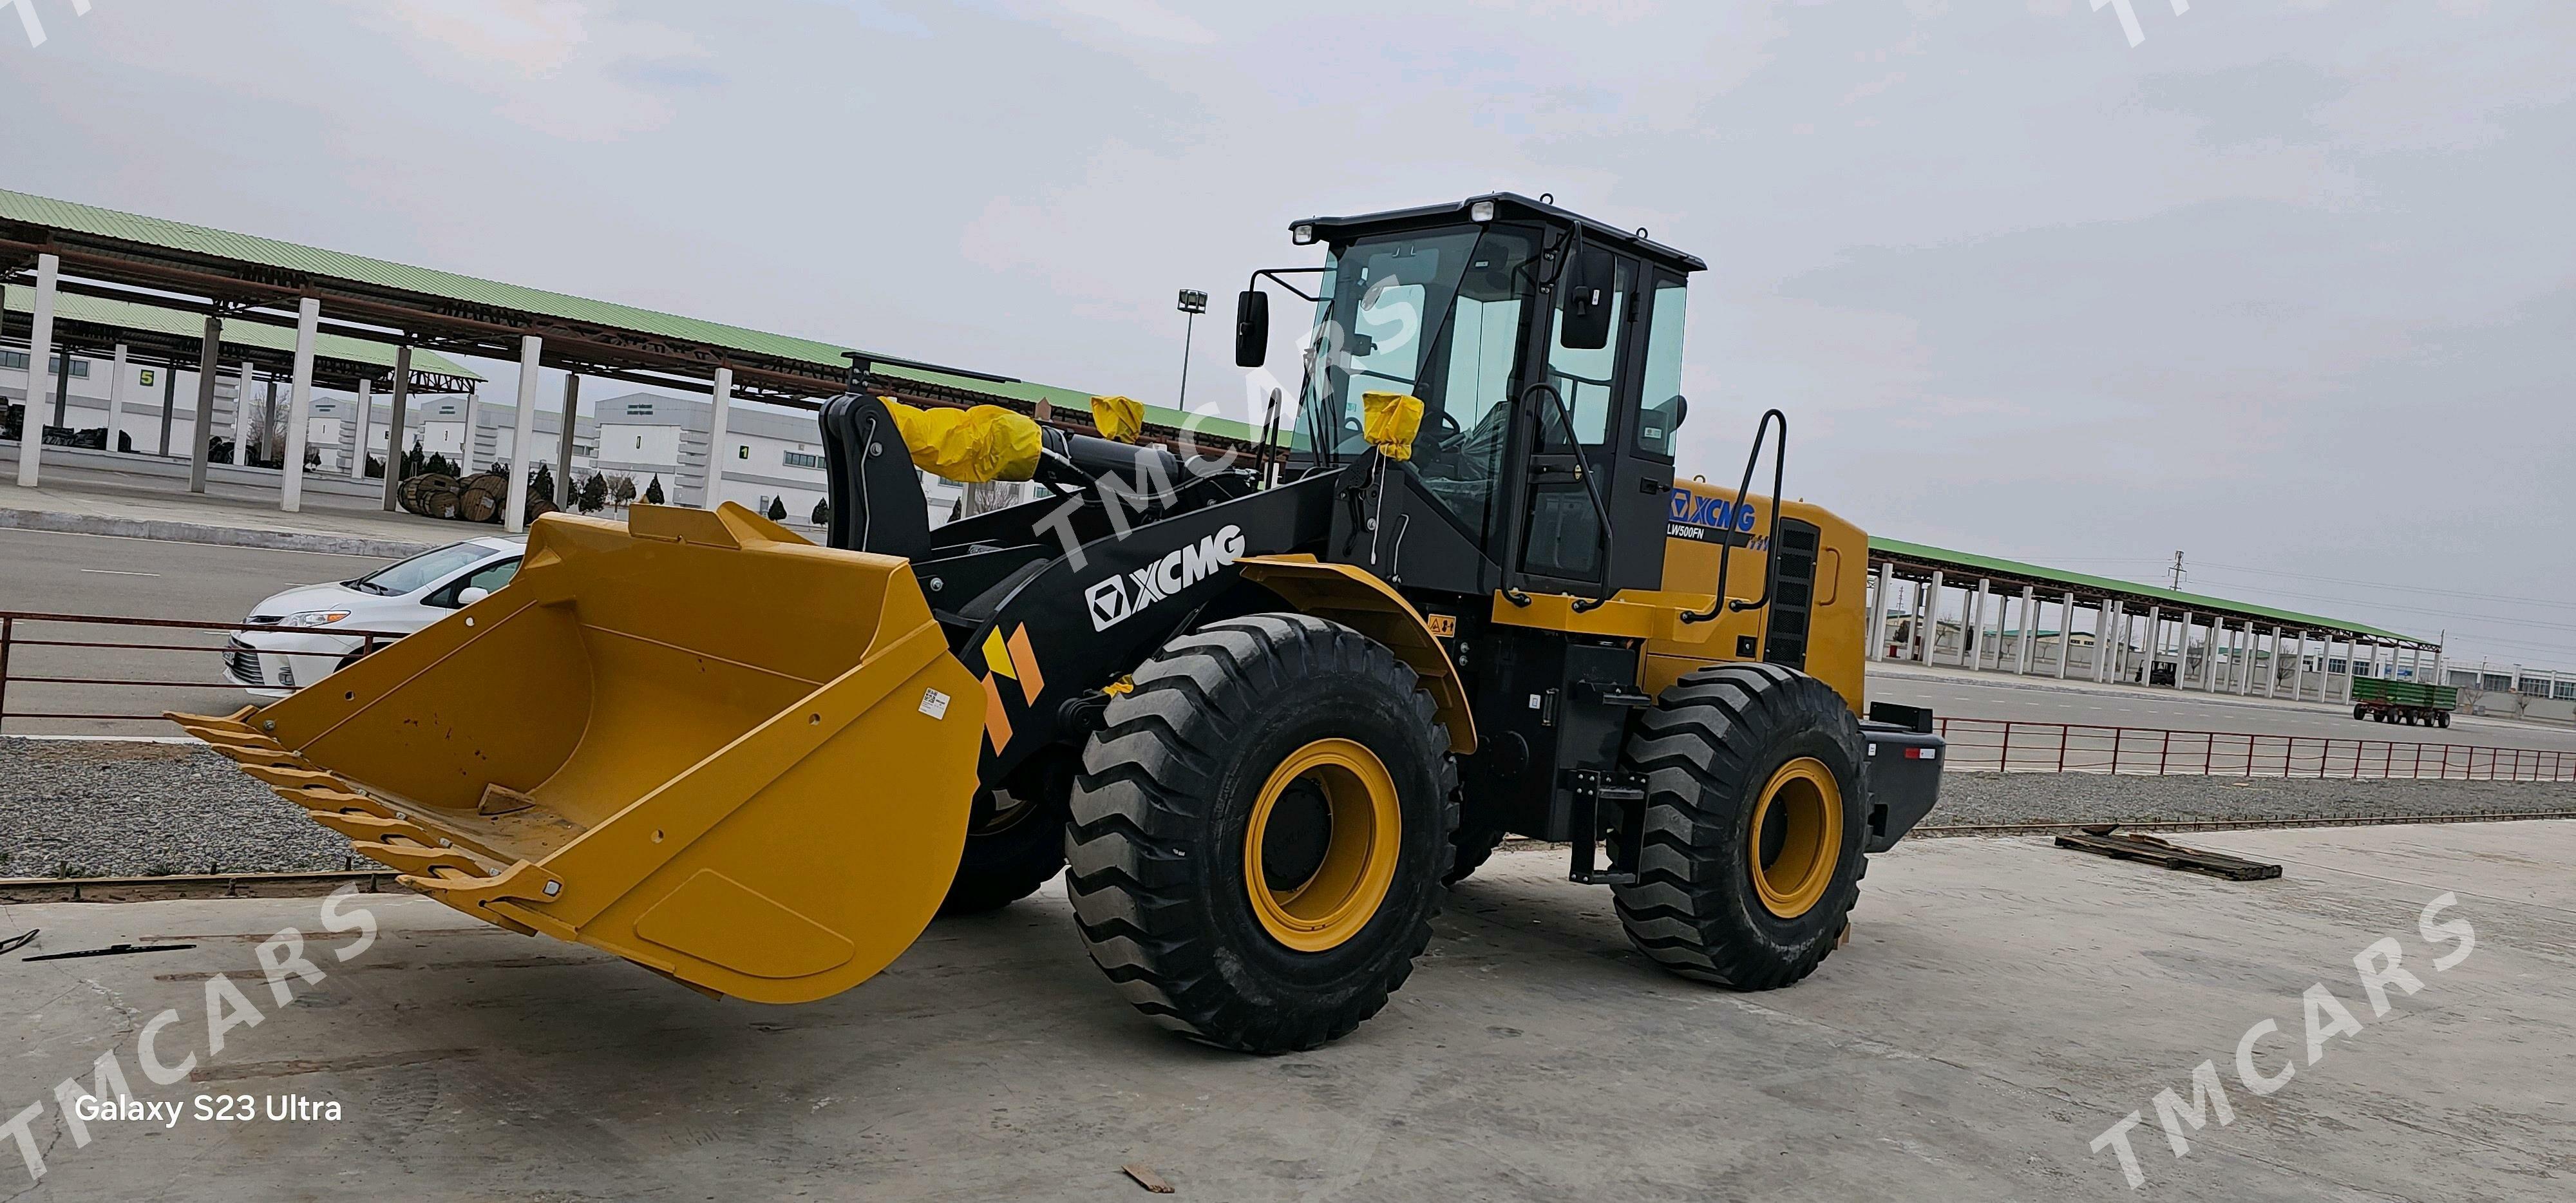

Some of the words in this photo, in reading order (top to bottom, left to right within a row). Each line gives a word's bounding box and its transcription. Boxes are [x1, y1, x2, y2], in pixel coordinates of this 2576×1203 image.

[141, 371, 153, 384] 5
[741, 447, 748, 458] 1
[1667, 523, 1705, 540] LW500FN
[1128, 525, 1245, 614] XCMG
